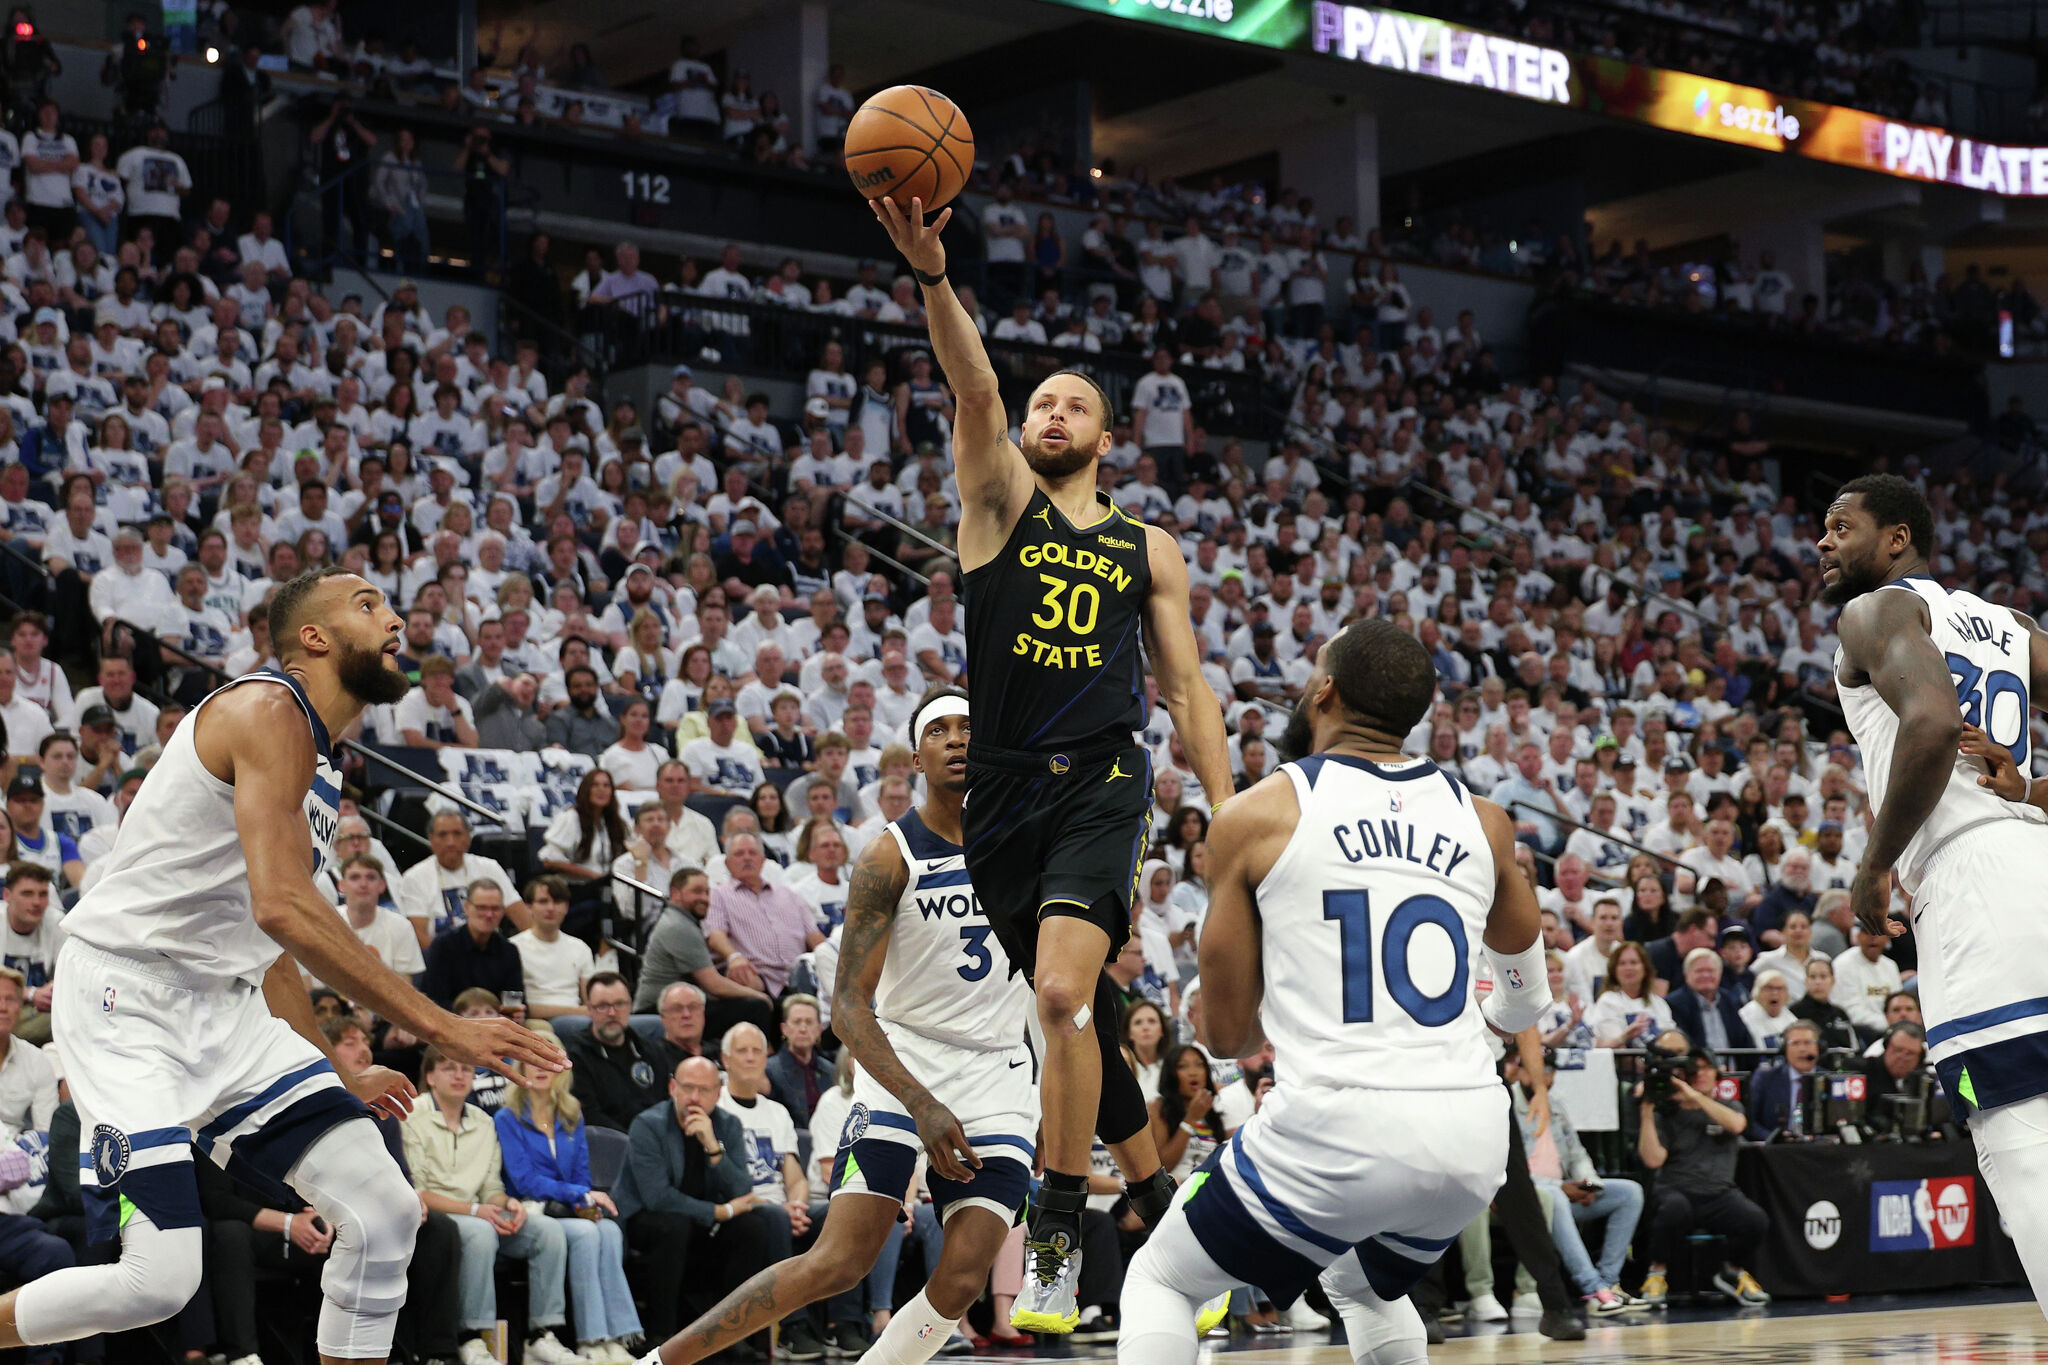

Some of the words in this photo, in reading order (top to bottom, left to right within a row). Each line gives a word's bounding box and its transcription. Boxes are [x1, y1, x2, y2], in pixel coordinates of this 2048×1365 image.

[1133, 0, 1234, 22] zzle
[1438, 26, 1571, 104] LATER
[1719, 102, 1801, 141] sezzle
[621, 170, 671, 204] 112
[1098, 534, 1136, 551] Rakuten
[1019, 542, 1132, 593] GOLDEN
[1031, 573, 1101, 635] 30
[1012, 633, 1103, 670] STATE
[1333, 819, 1470, 877] CONLEY
[915, 892, 987, 922] WOL
[956, 924, 993, 983] 3
[1322, 888, 1470, 1028] 10
[1803, 1216, 1842, 1236] TNT
[1878, 1194, 1912, 1238] NBA
[1937, 1204, 1970, 1226] TNT
